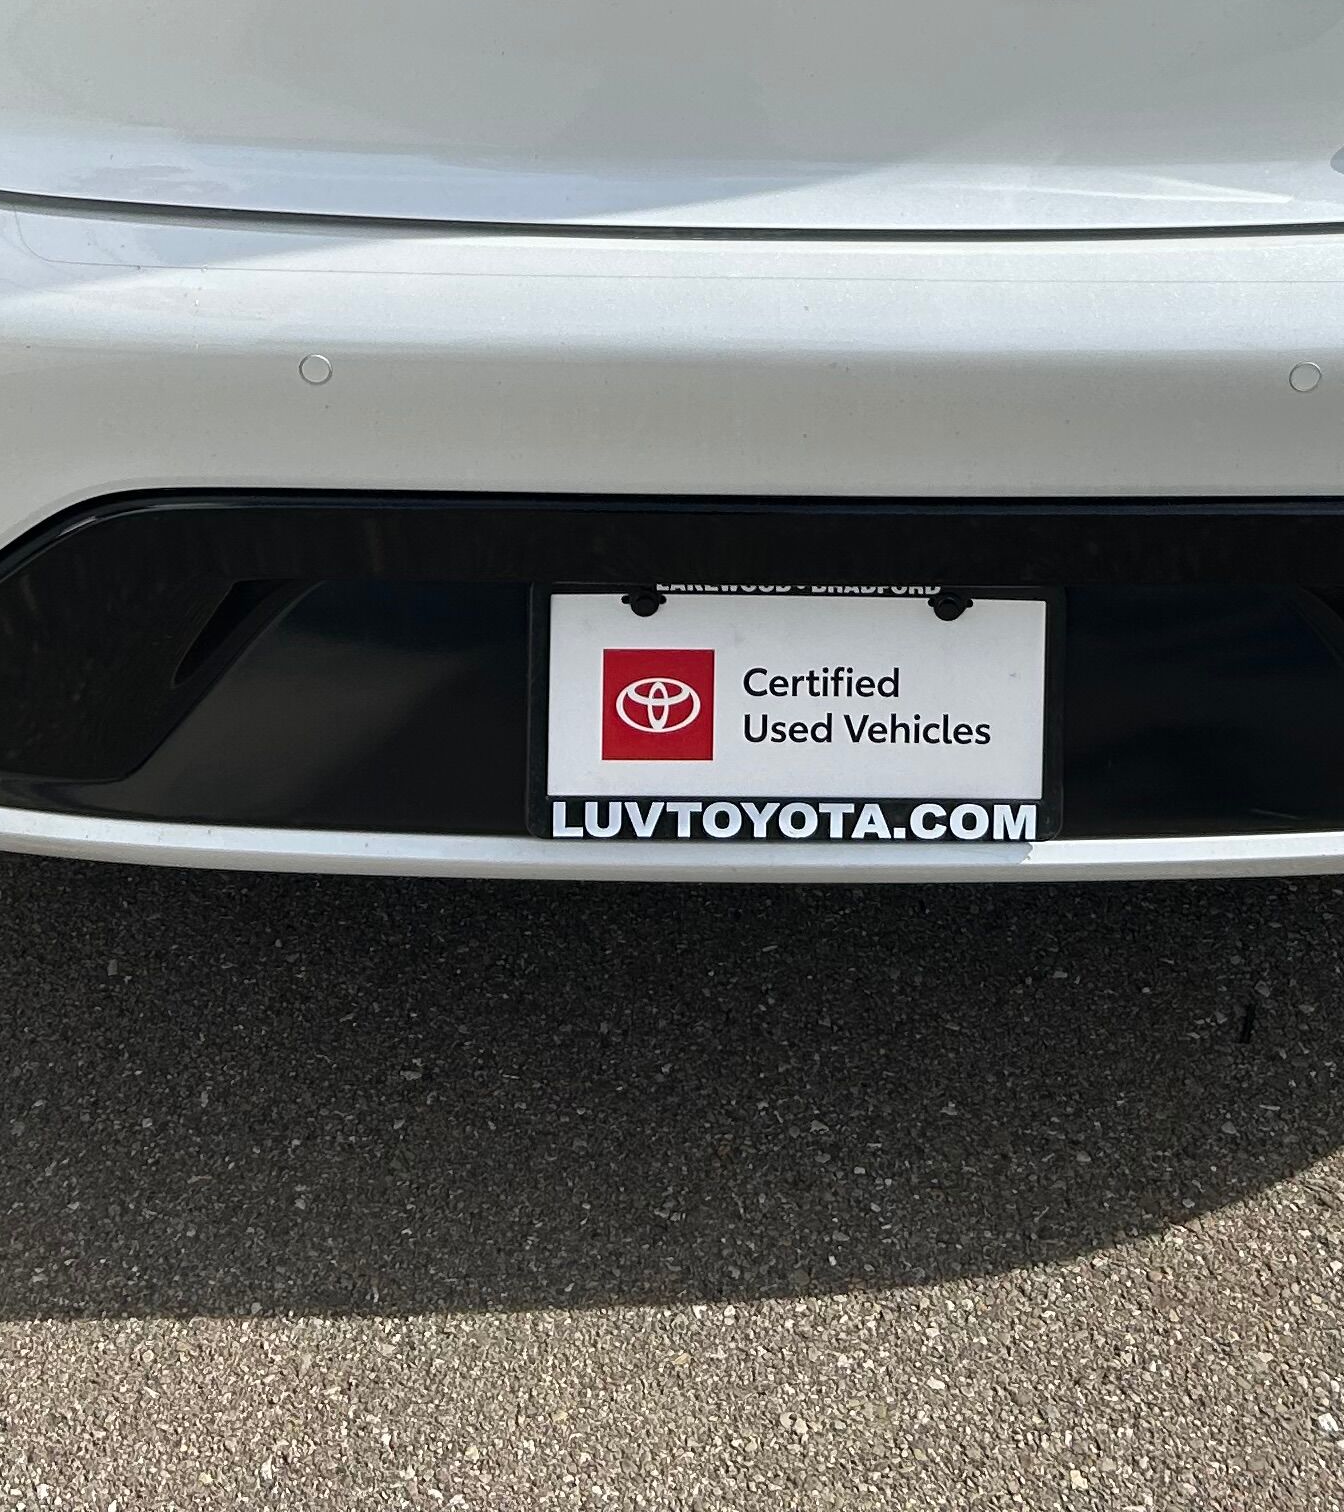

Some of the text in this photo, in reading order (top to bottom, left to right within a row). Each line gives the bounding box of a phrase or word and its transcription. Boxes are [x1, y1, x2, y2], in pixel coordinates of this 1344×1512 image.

[743, 667, 899, 699] Certified
[744, 714, 991, 746] Used Vehicles
[552, 801, 1037, 840] LUVTOYOTA.COM
